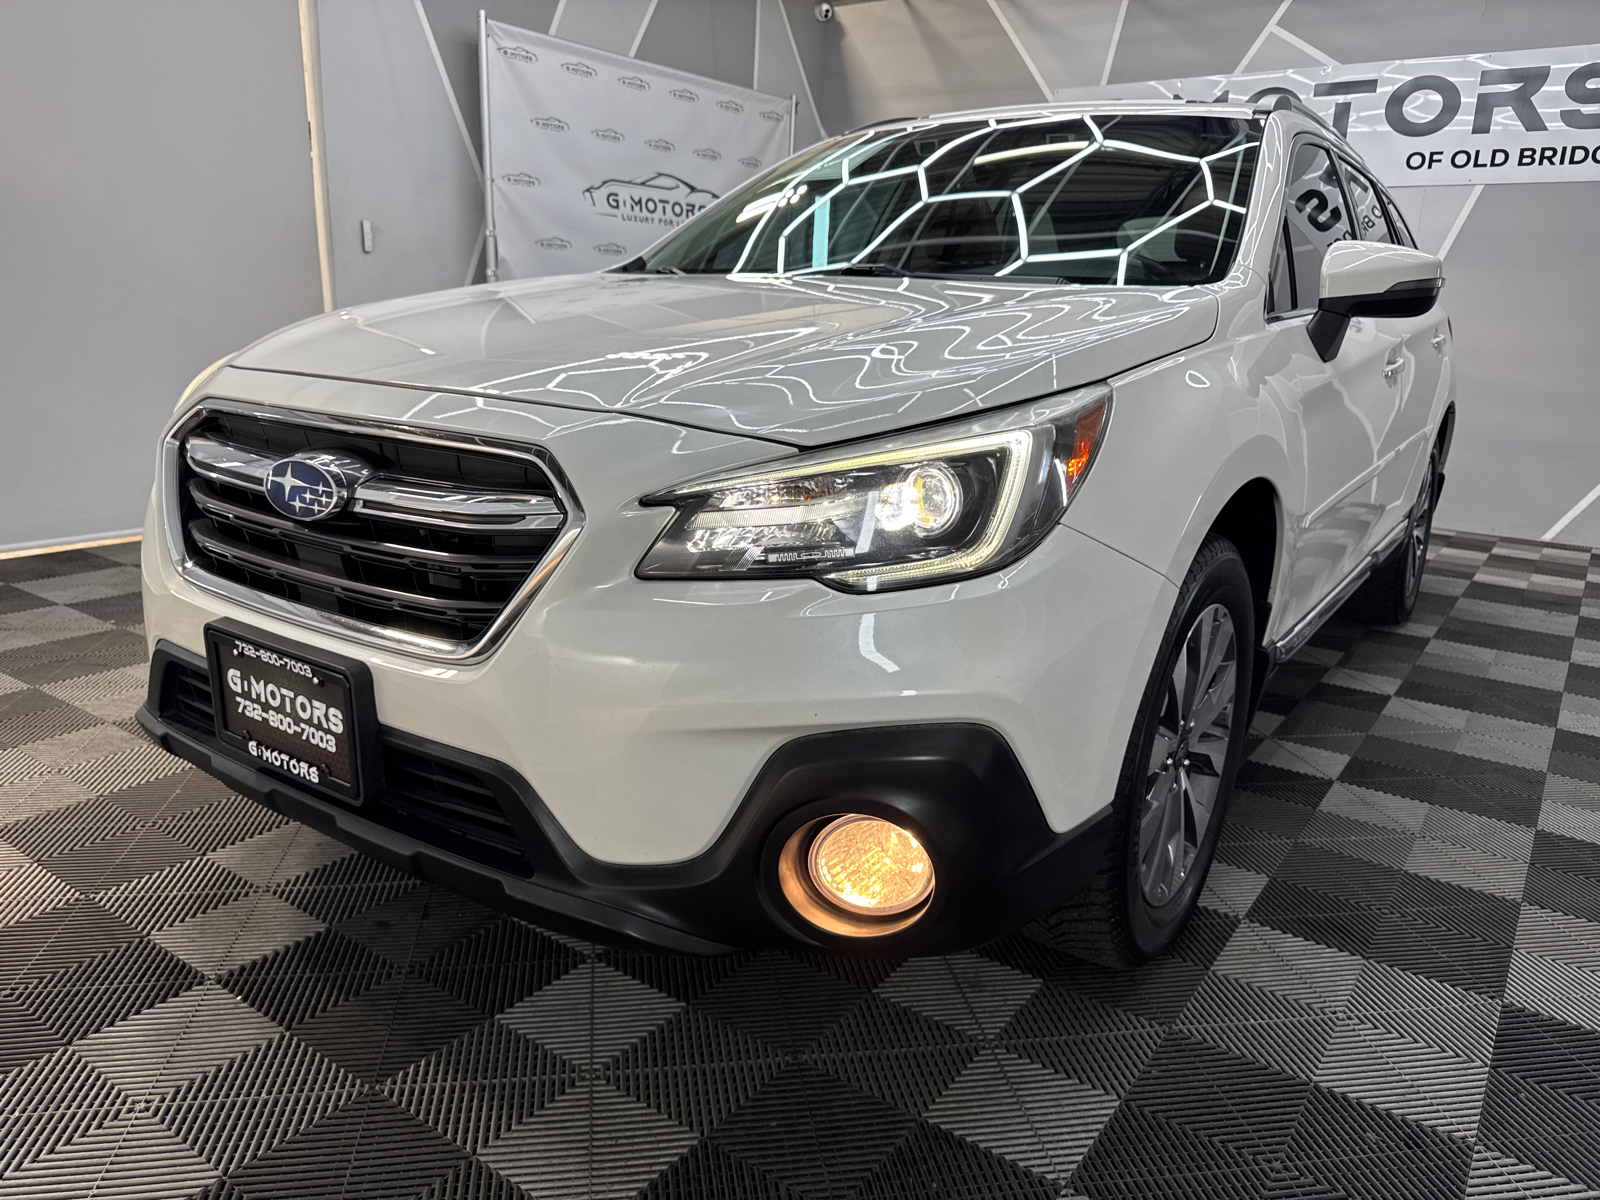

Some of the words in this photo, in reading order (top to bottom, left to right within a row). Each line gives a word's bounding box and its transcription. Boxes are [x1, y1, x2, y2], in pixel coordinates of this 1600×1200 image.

[1405, 151, 1444, 170] OF
[1450, 149, 1510, 168] OLD
[621, 213, 654, 225] LUXURY
[235, 640, 312, 678] 732-800-7003
[235, 696, 337, 753] 732-800-7003
